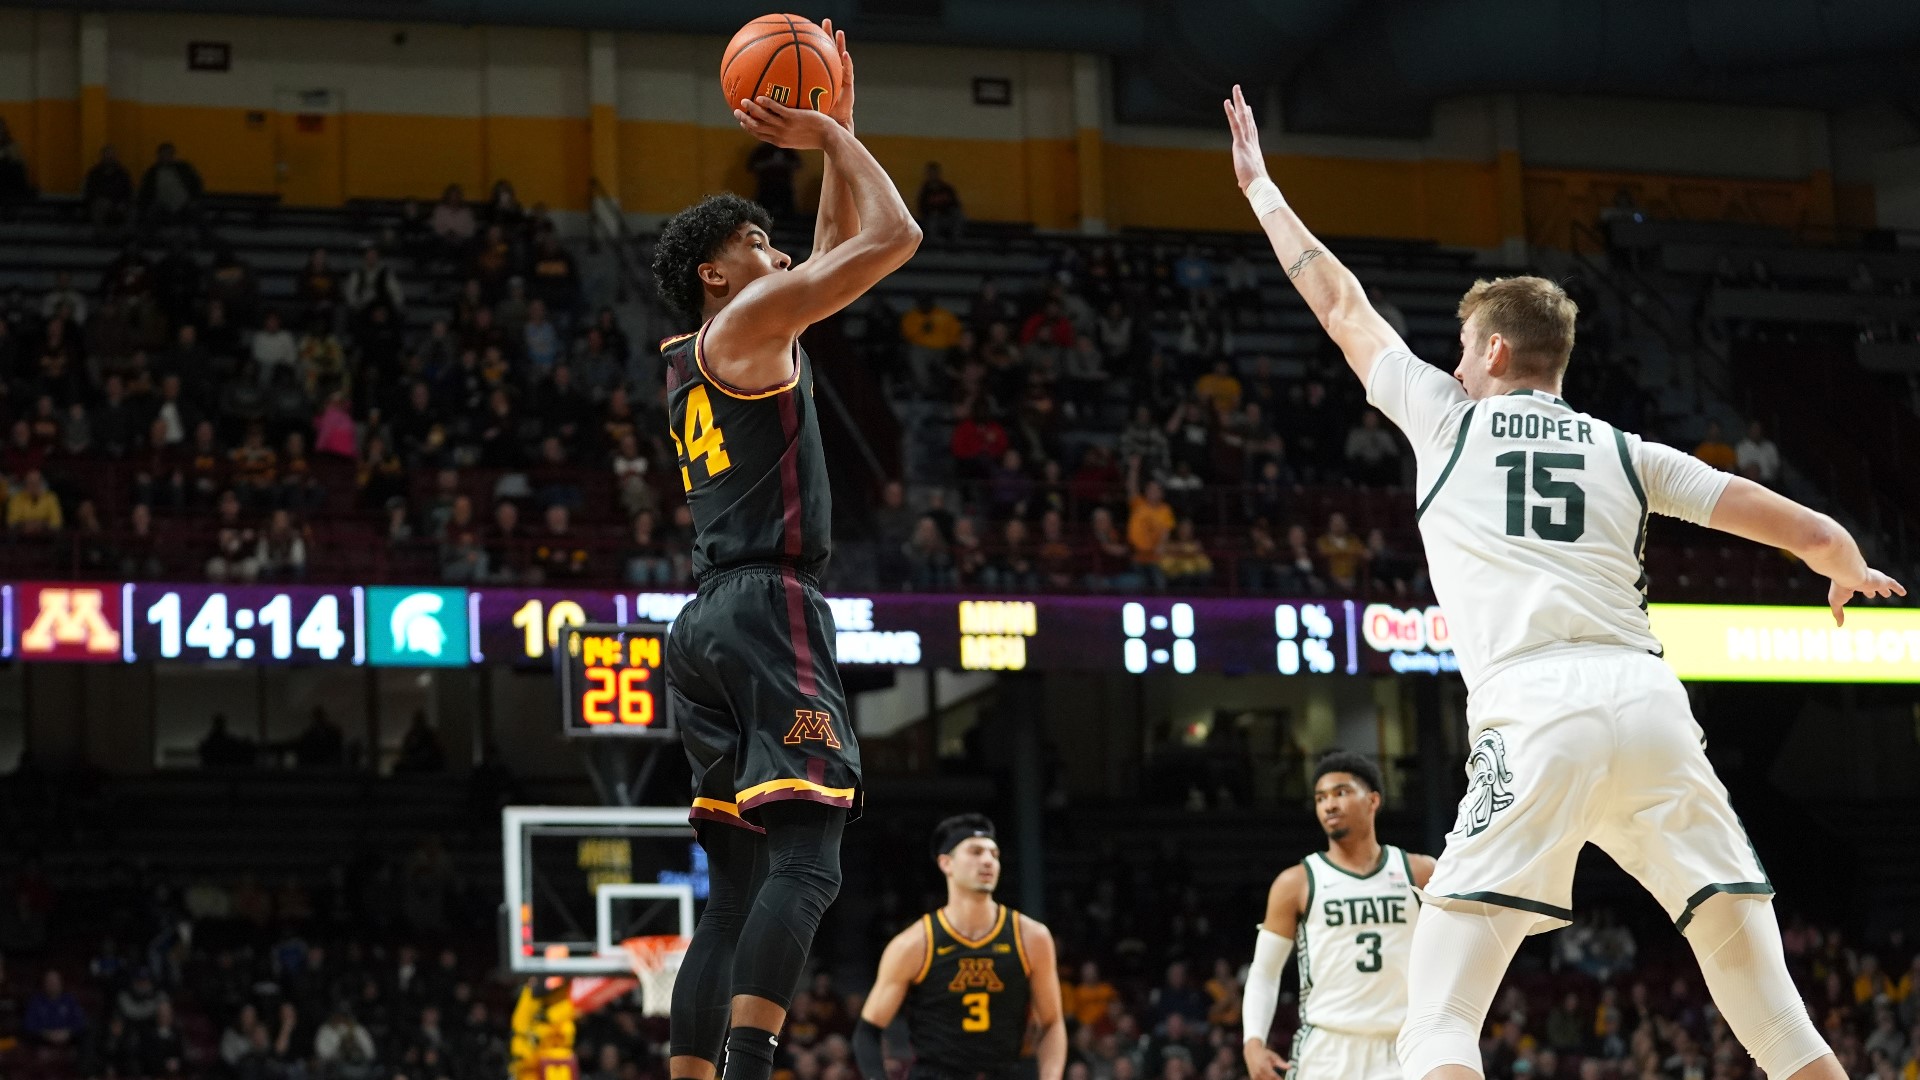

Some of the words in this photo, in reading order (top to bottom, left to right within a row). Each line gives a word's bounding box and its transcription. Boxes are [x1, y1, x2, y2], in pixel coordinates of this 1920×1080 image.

[668, 383, 731, 493] 4
[1491, 411, 1595, 445] COOPER
[1495, 450, 1586, 543] 15
[147, 591, 345, 659] 14:14
[583, 666, 655, 726] 26
[783, 709, 842, 750] M
[1323, 895, 1408, 928] STATE
[1355, 932, 1383, 974] 3
[948, 957, 1005, 992] M
[961, 992, 991, 1032] 3
